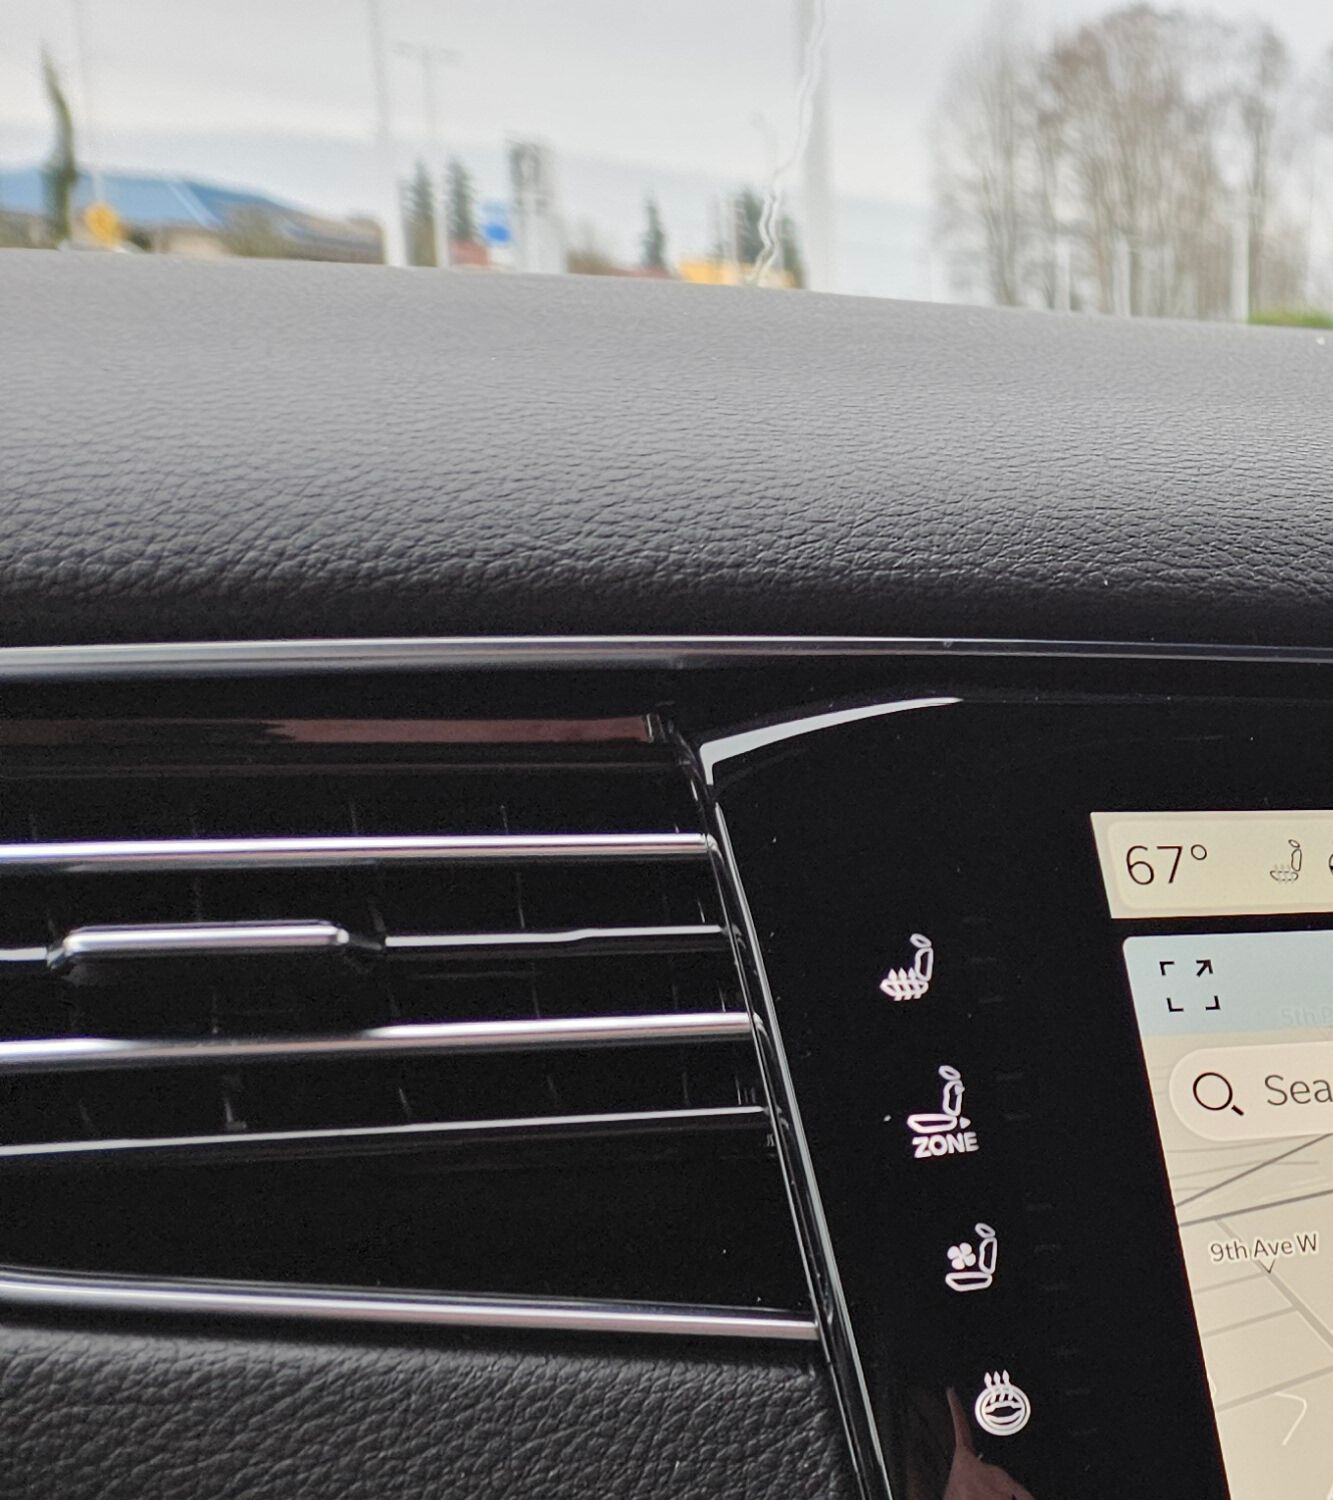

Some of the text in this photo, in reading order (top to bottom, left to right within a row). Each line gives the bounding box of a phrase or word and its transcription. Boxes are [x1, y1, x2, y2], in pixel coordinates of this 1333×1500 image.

[1126, 844, 1208, 886] 67°
[911, 1132, 980, 1159] ZONE
[1210, 1233, 1317, 1261] 9th Ave W
